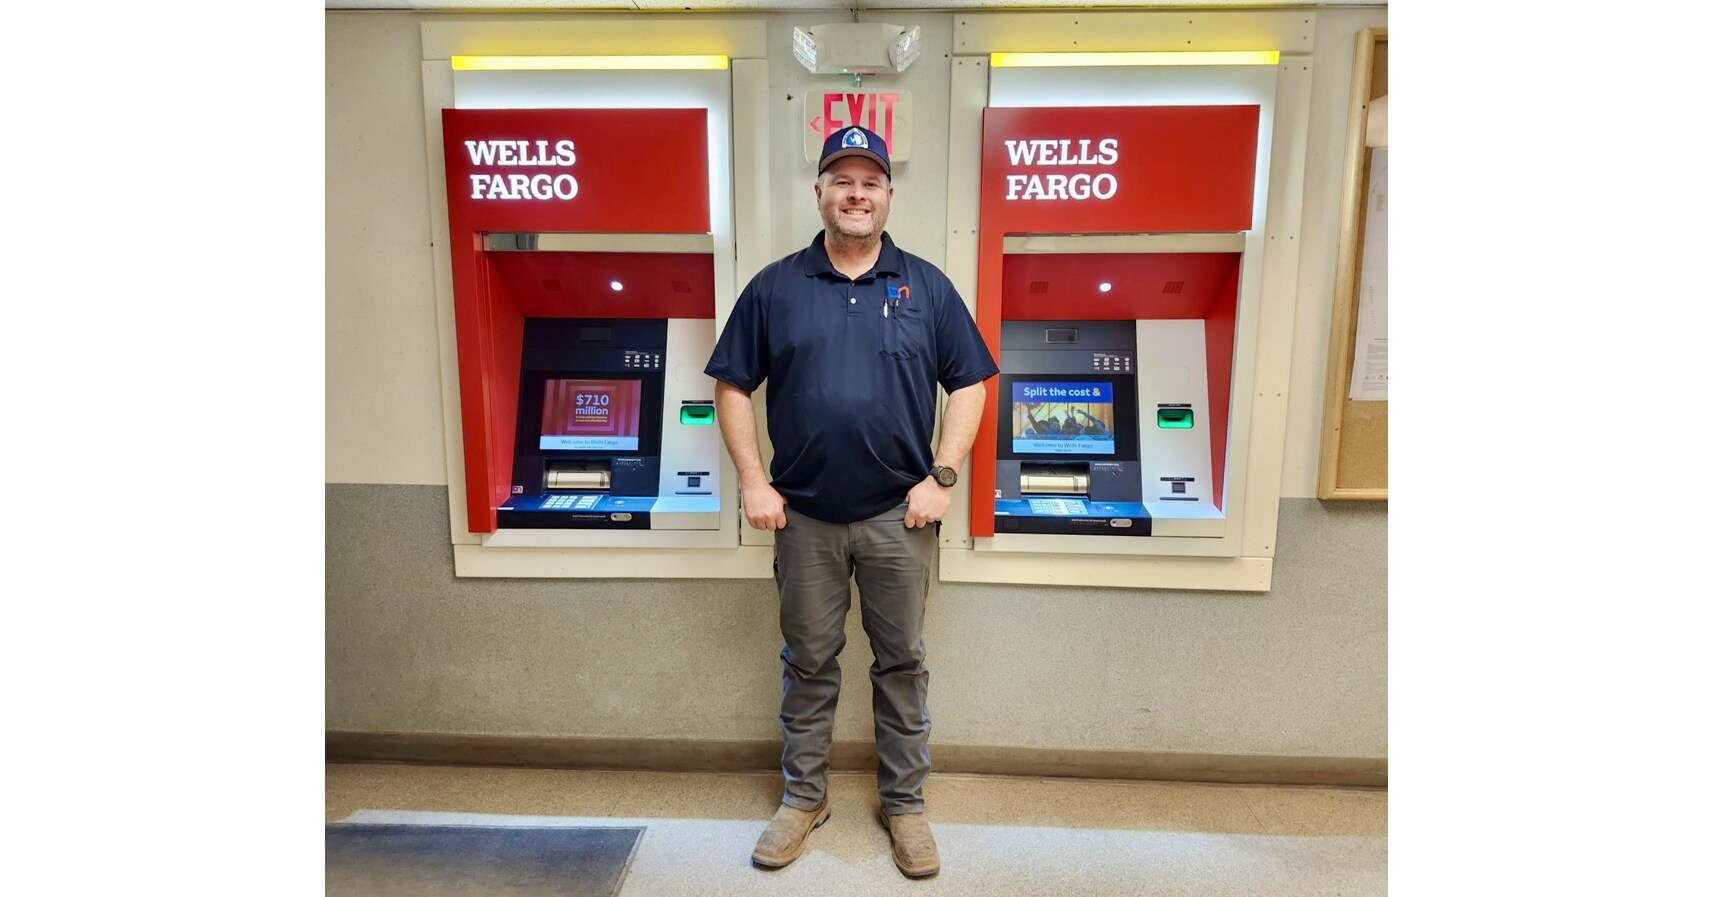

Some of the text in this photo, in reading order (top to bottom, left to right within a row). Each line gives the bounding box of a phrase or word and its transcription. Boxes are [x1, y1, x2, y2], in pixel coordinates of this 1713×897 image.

[464, 140, 576, 166] WELLS
[1005, 138, 1118, 166] WELLS
[470, 174, 578, 200] FARGO
[1006, 173, 1118, 200] FARGO
[575, 394, 609, 406] $710
[1023, 387, 1101, 398] Split the cost &
[575, 406, 609, 415] million
